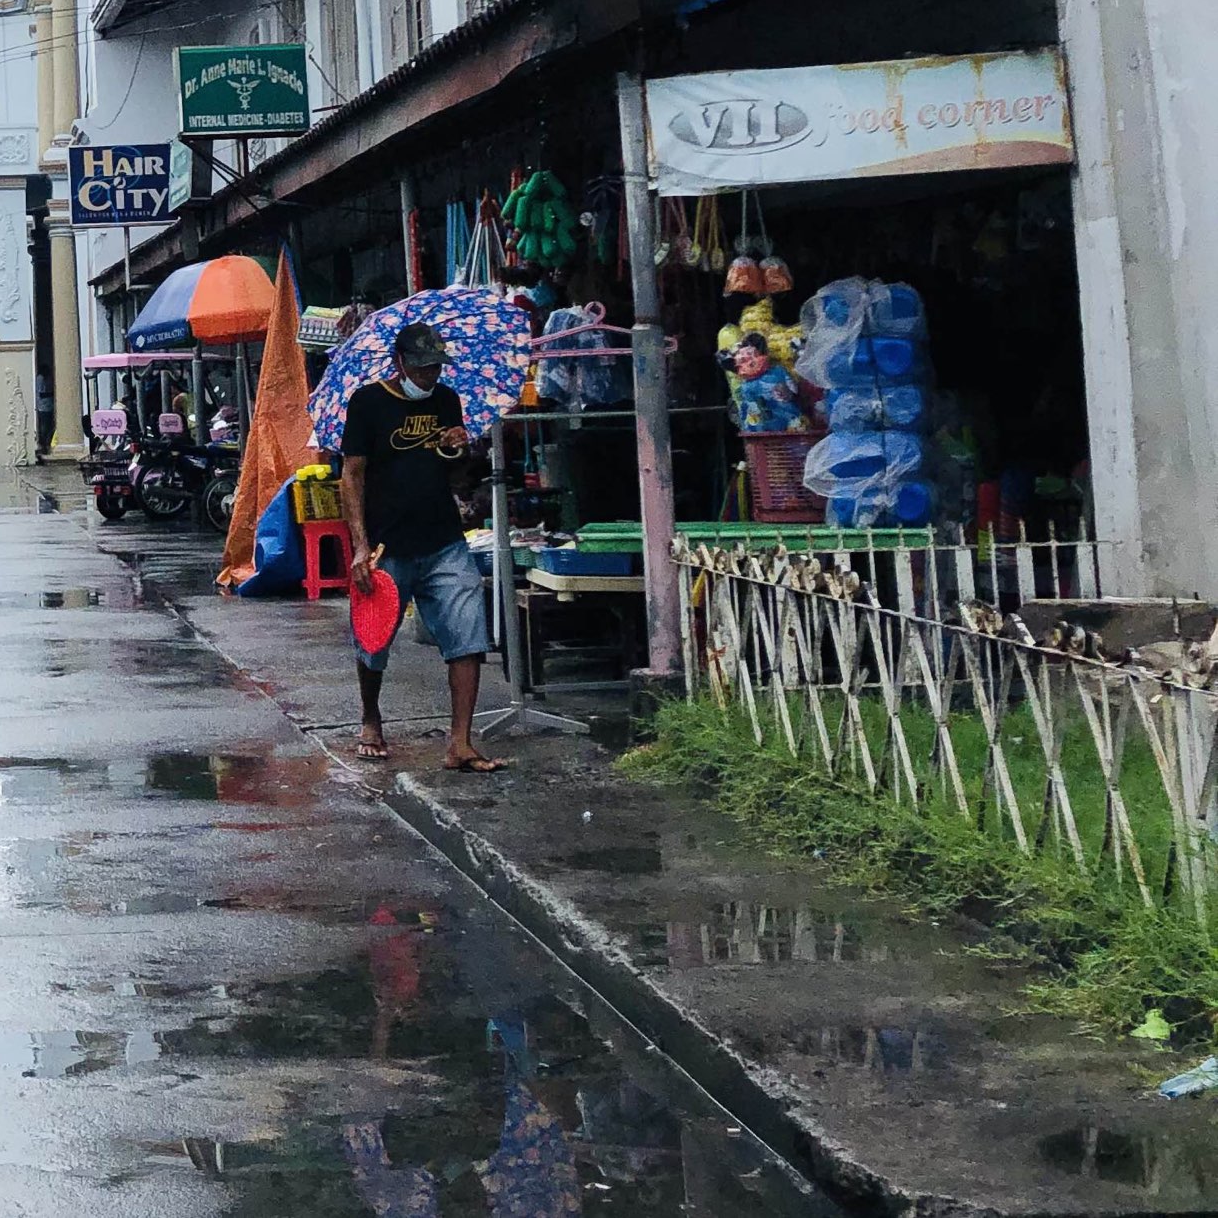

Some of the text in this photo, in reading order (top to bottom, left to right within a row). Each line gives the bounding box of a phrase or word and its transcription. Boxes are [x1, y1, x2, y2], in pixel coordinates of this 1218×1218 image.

[200, 62, 226, 87] Anne
[227, 53, 256, 76] Marie
[267, 61, 304, 95] Ignacio
[188, 114, 226, 128] INTERNAL
[917, 94, 1057, 130] corner
[83, 149, 166, 177] HAIR
[402, 415, 439, 435] NIKE
